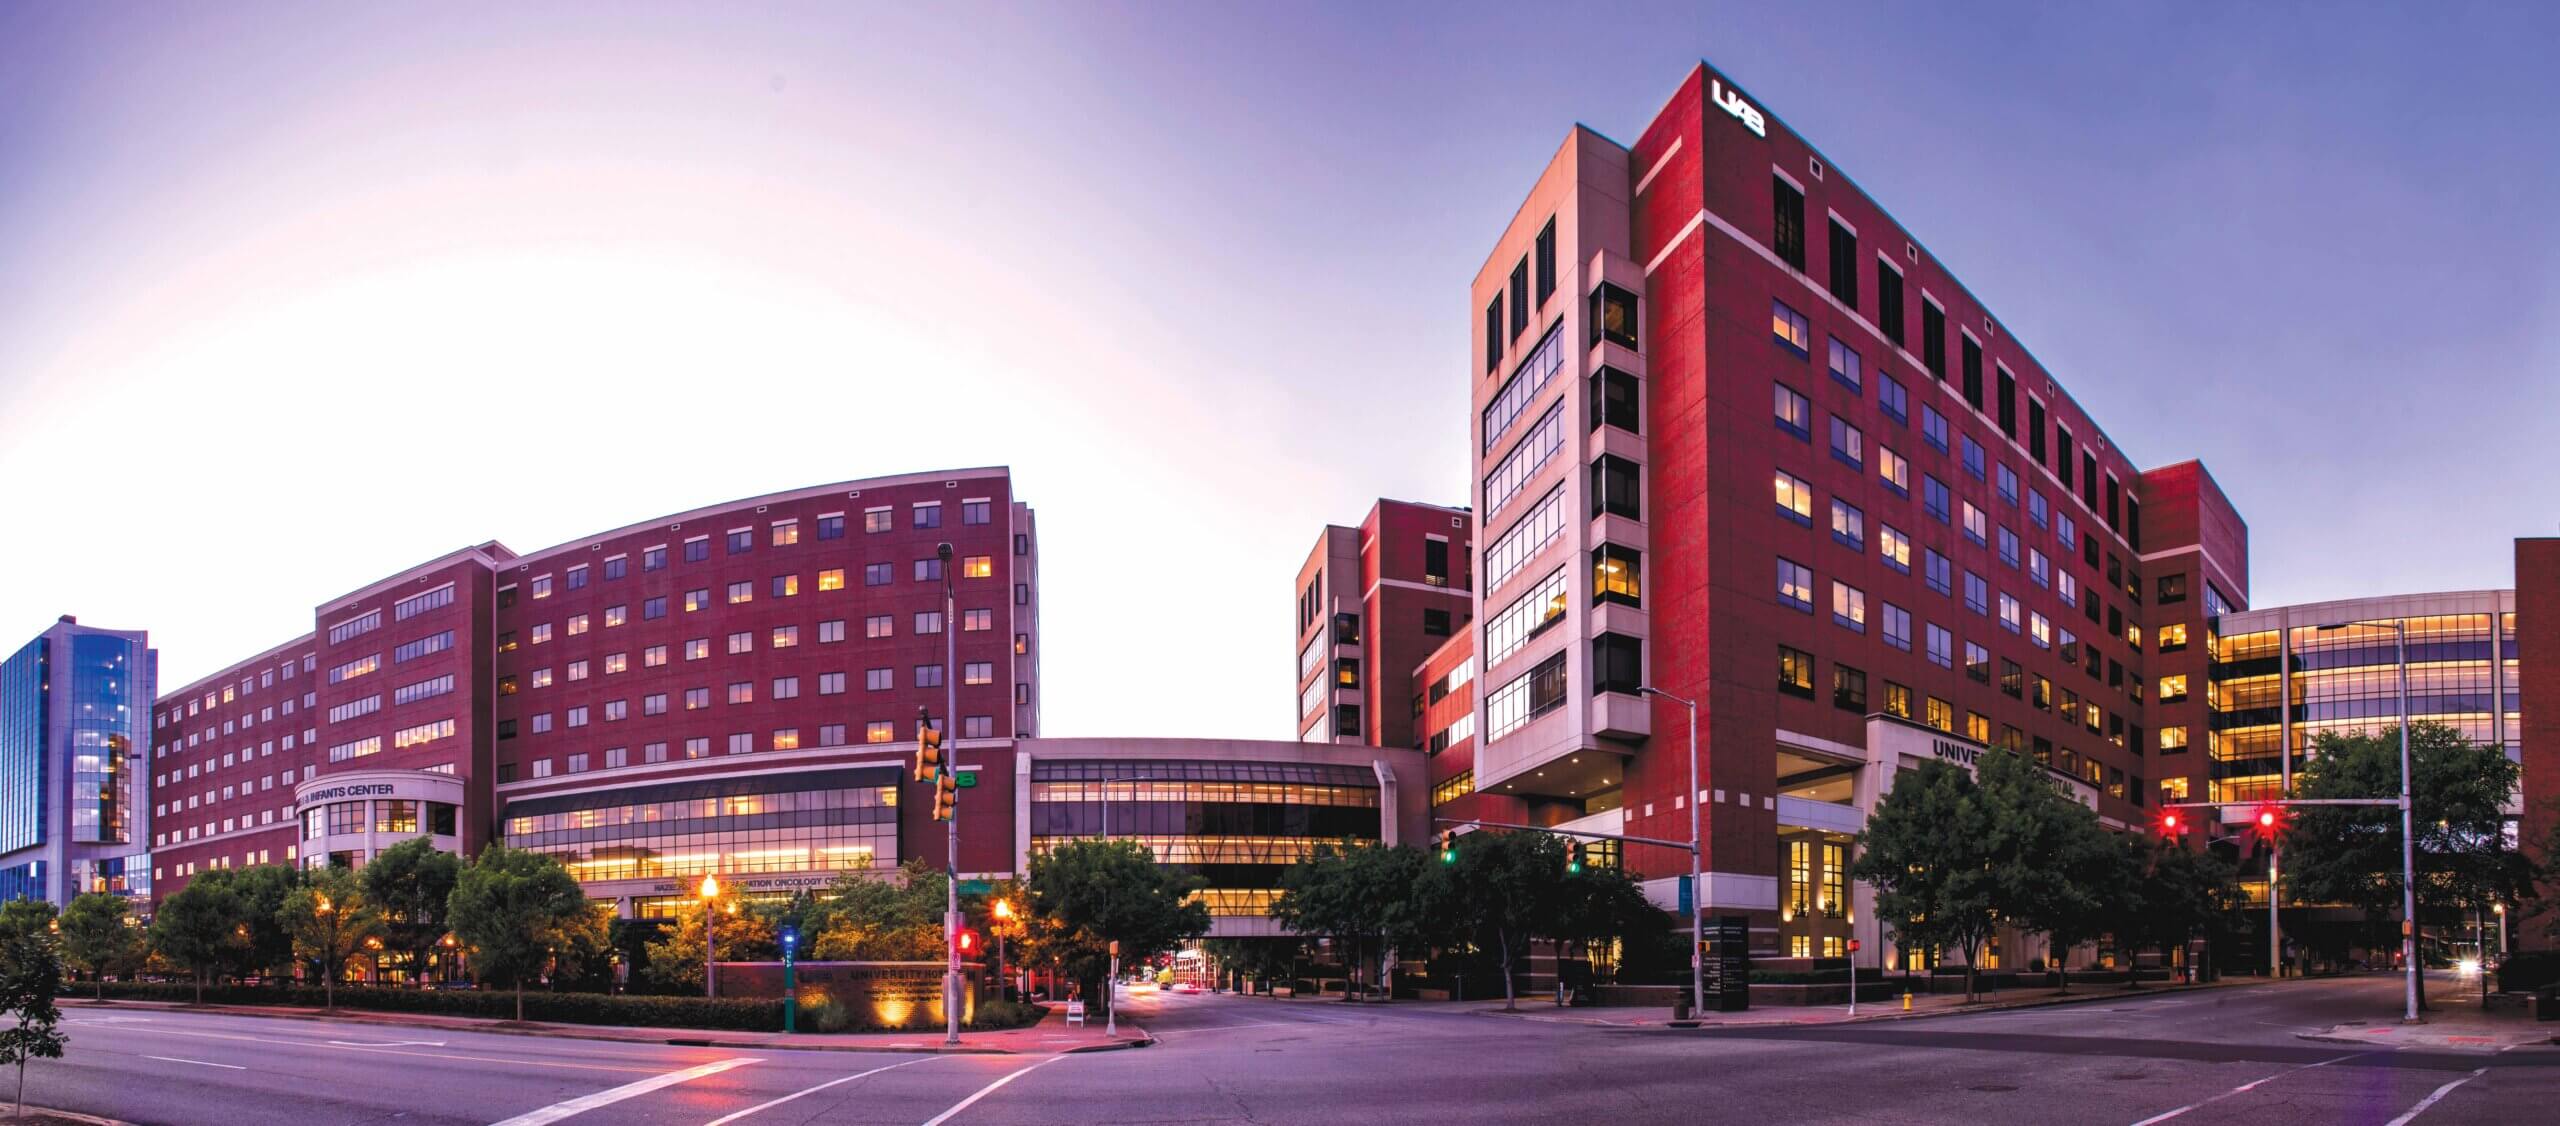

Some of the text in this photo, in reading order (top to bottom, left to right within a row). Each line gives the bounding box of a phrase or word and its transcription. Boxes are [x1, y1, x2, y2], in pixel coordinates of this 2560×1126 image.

[1711, 79, 1766, 138] UAB
[310, 786, 346, 802] INFANTS
[347, 783, 394, 796] CENTER
[774, 877, 822, 888] ONCOLOGY
